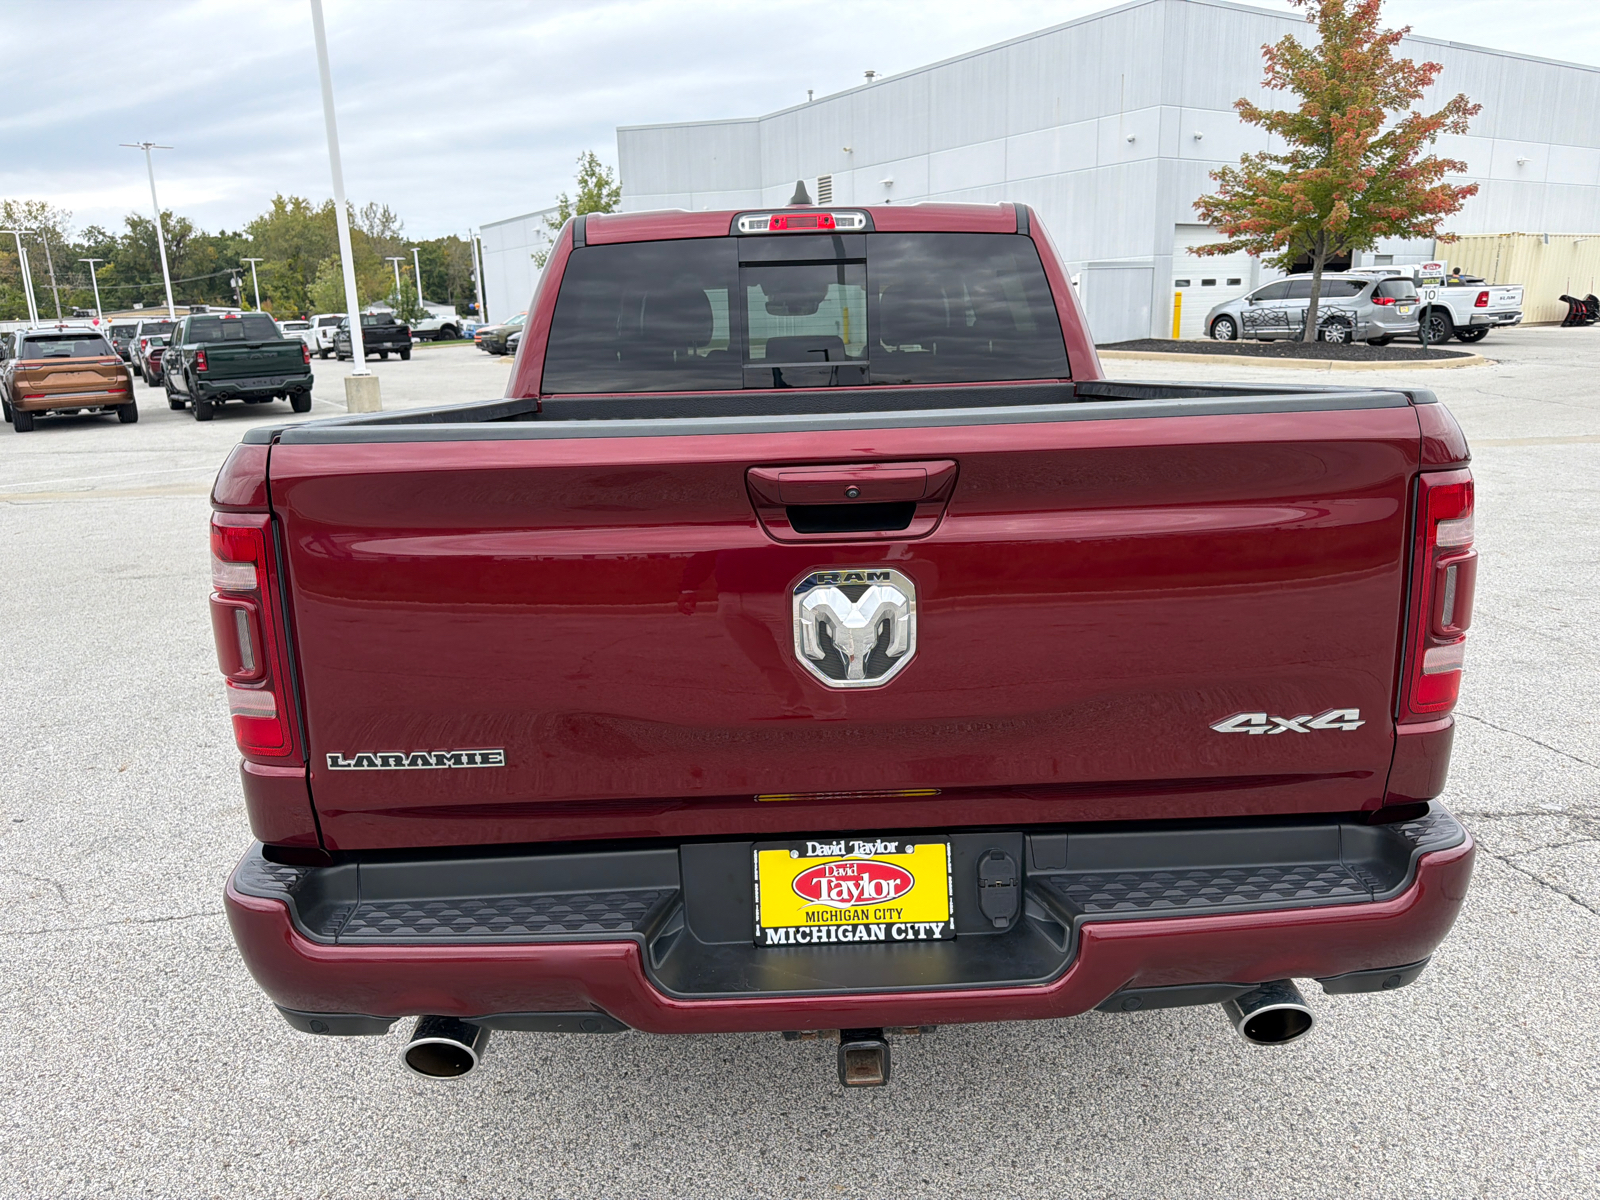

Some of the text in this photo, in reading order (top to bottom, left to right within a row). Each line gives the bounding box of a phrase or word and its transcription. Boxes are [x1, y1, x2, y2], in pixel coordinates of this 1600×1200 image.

[1424, 290, 1436, 300] 10
[817, 571, 891, 584] RAM
[326, 749, 506, 770] LARAMIE
[806, 839, 898, 858] David Taylor
[825, 864, 857, 877] David
[802, 873, 901, 909] Taylor
[805, 908, 904, 923] MICHIGAN CITY
[765, 922, 944, 945] MICHIGAN CITY
